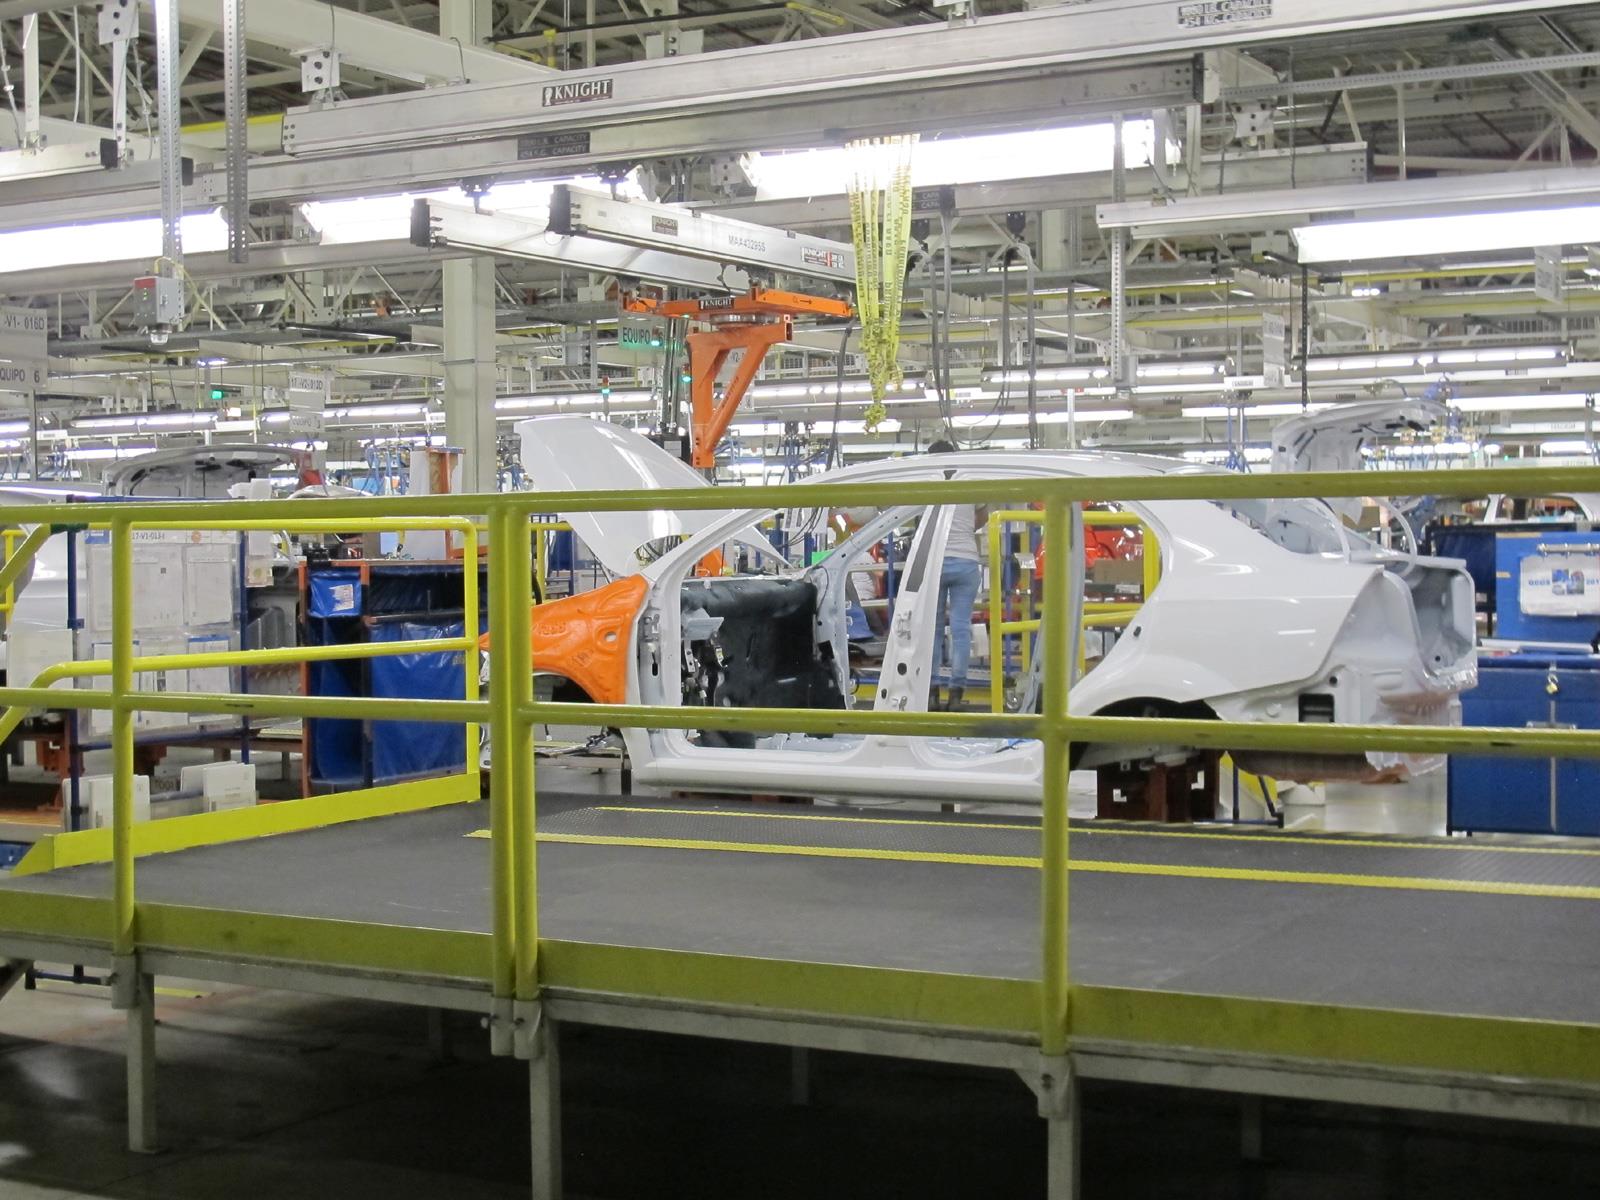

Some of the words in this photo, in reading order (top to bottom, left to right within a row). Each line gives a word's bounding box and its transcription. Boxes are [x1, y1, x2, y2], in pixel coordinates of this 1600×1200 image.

[555, 80, 611, 100] KNIGHT
[704, 297, 732, 307] KNIGHT
[622, 326, 651, 345] EQUIPO
[34, 370, 40, 383] 6
